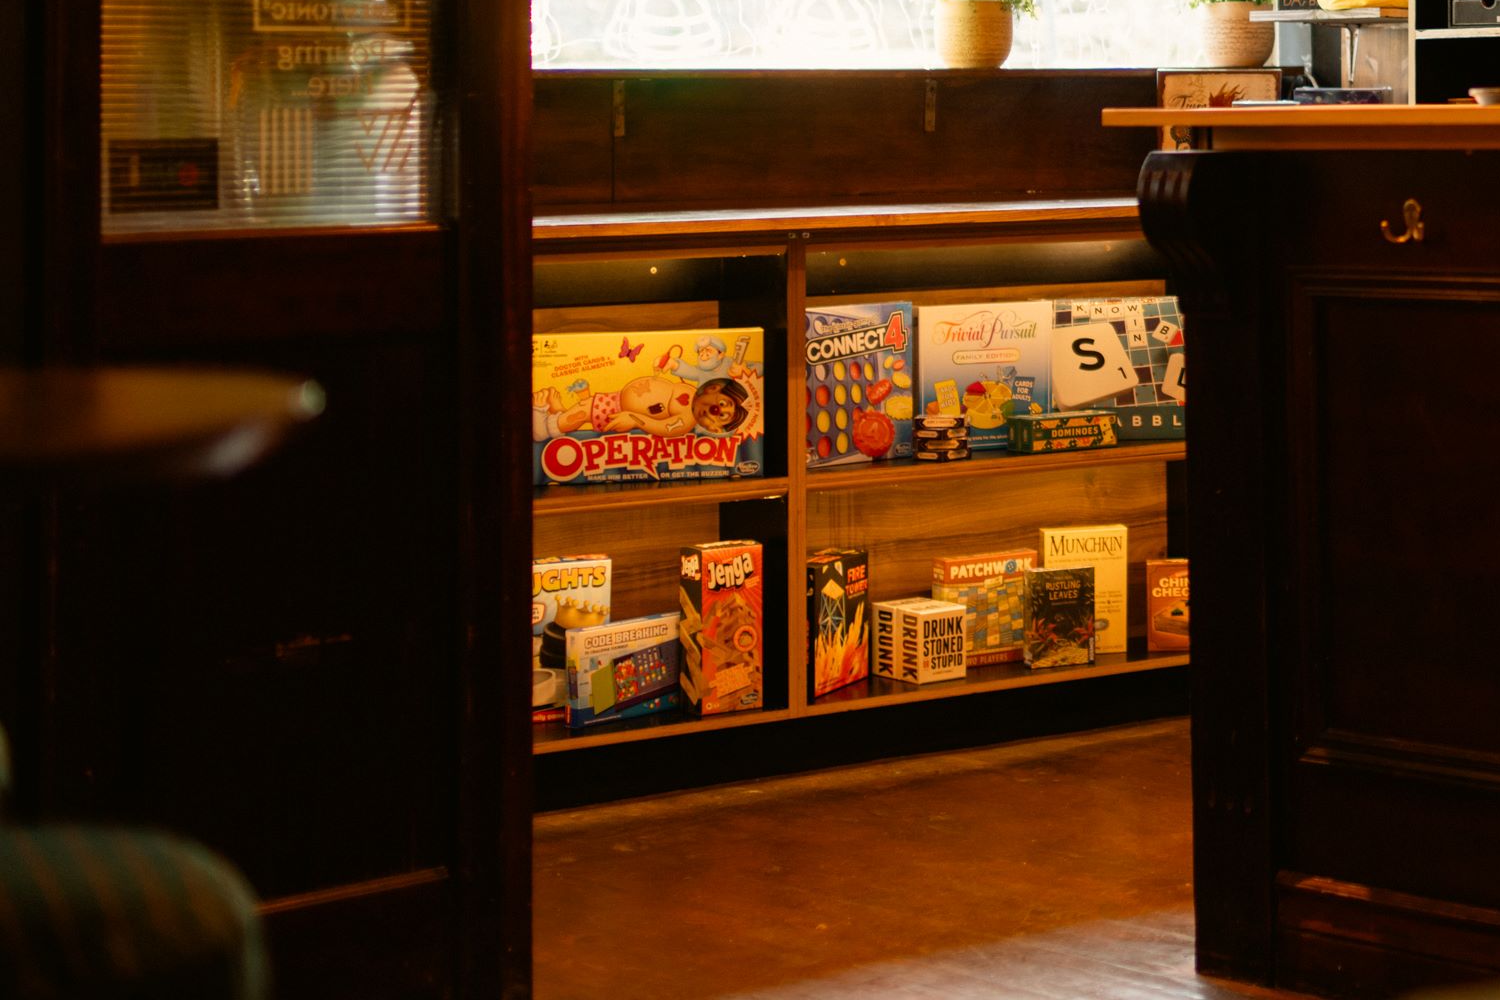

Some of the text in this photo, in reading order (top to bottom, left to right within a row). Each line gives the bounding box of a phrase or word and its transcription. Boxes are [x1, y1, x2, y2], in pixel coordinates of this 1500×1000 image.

[807, 314, 905, 362] CONNECT 4
[933, 314, 1037, 348] Trivial Pursuit
[956, 351, 1018, 361] FAMILY EDITION
[1072, 338, 1105, 371] S
[1014, 380, 1034, 388] CARDS
[1012, 393, 1032, 401] ADULTS
[1051, 426, 1099, 438] DOMINOES
[544, 435, 740, 478] OPERATION
[707, 552, 755, 590] Jenga
[847, 565, 866, 583] FIRE
[1045, 580, 1081, 590] RUSTLING
[1049, 590, 1078, 600] LEAVES
[585, 625, 668, 649] CODE BREAKING
[924, 616, 963, 639] DRUNK
[879, 610, 893, 676] DRUNK
[903, 614, 917, 680] DRUNK
[924, 636, 963, 657] STONED
[931, 653, 962, 670] STUPID
